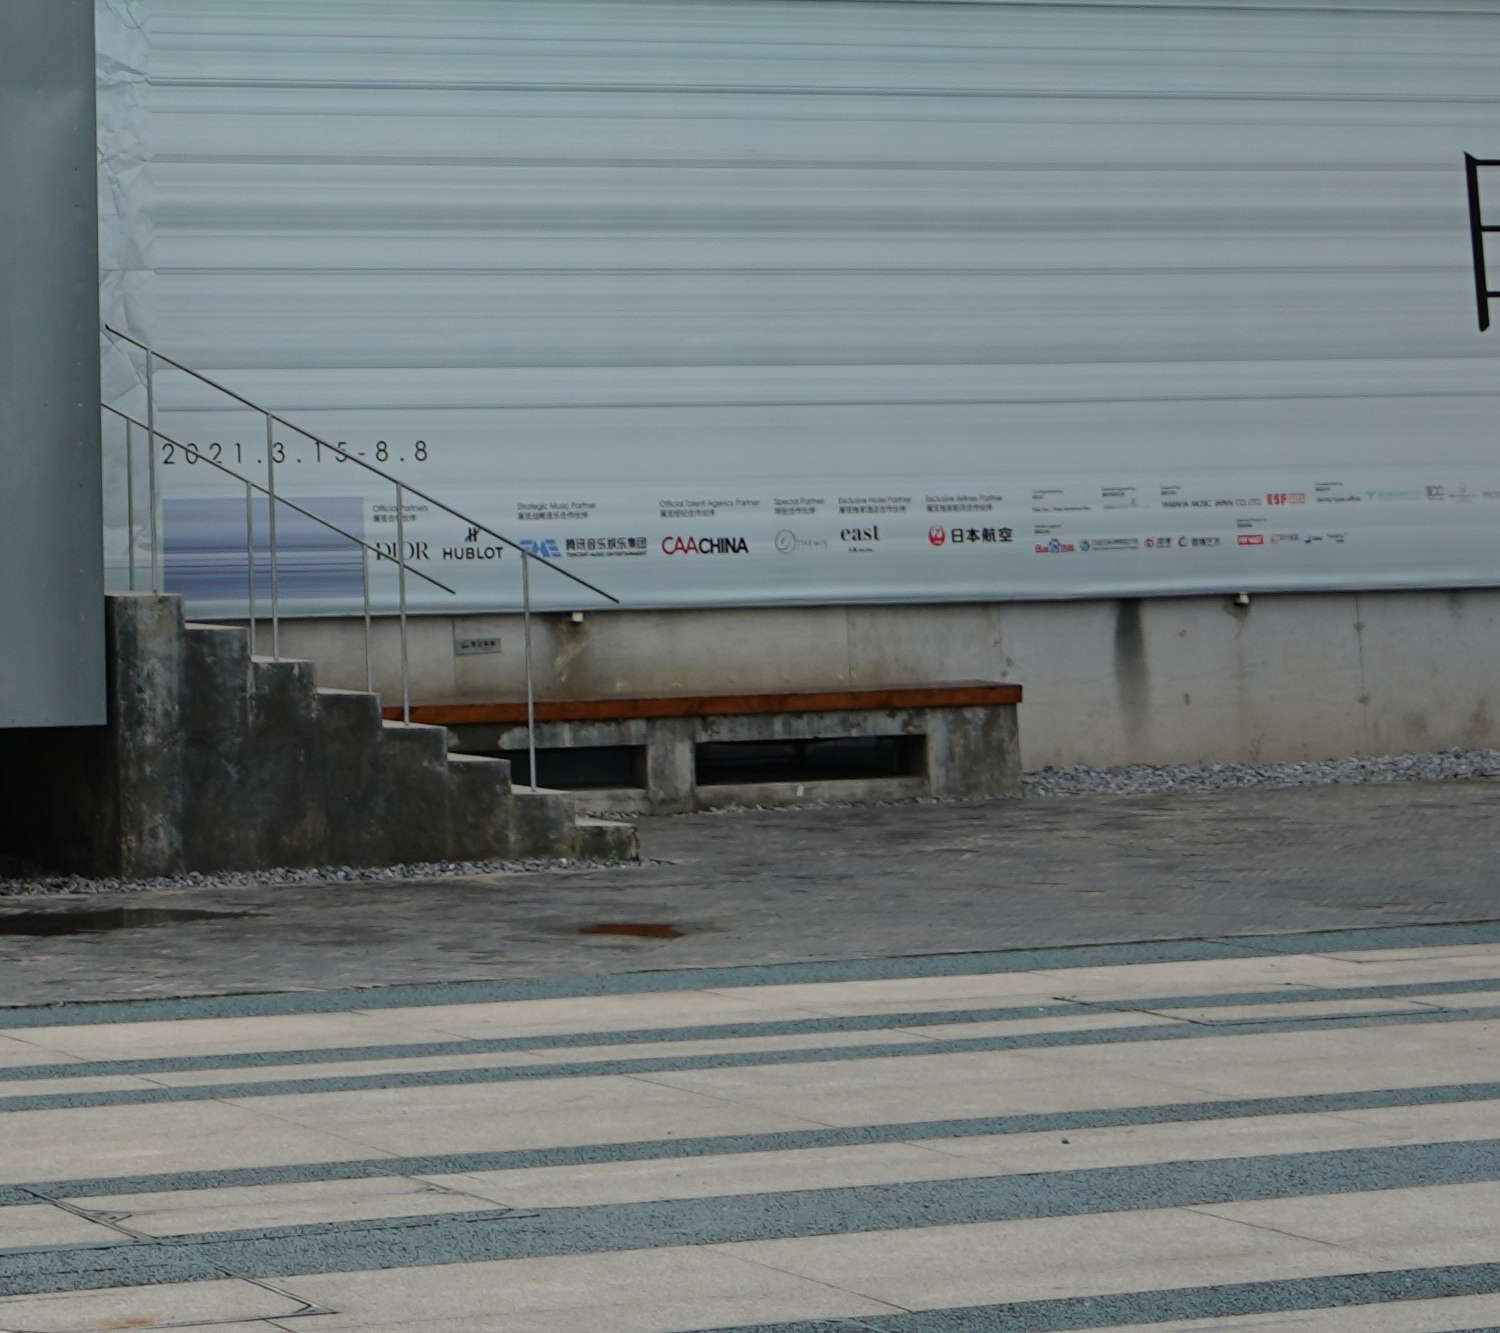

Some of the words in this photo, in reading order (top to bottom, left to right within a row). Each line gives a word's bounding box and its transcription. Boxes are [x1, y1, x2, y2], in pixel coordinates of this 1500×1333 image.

[372, 503, 398, 513] Officia
[840, 525, 881, 542] east
[951, 526, 1014, 544] 日本航空
[376, 541, 430, 560] DIOR
[442, 546, 504, 560] HUBLOT
